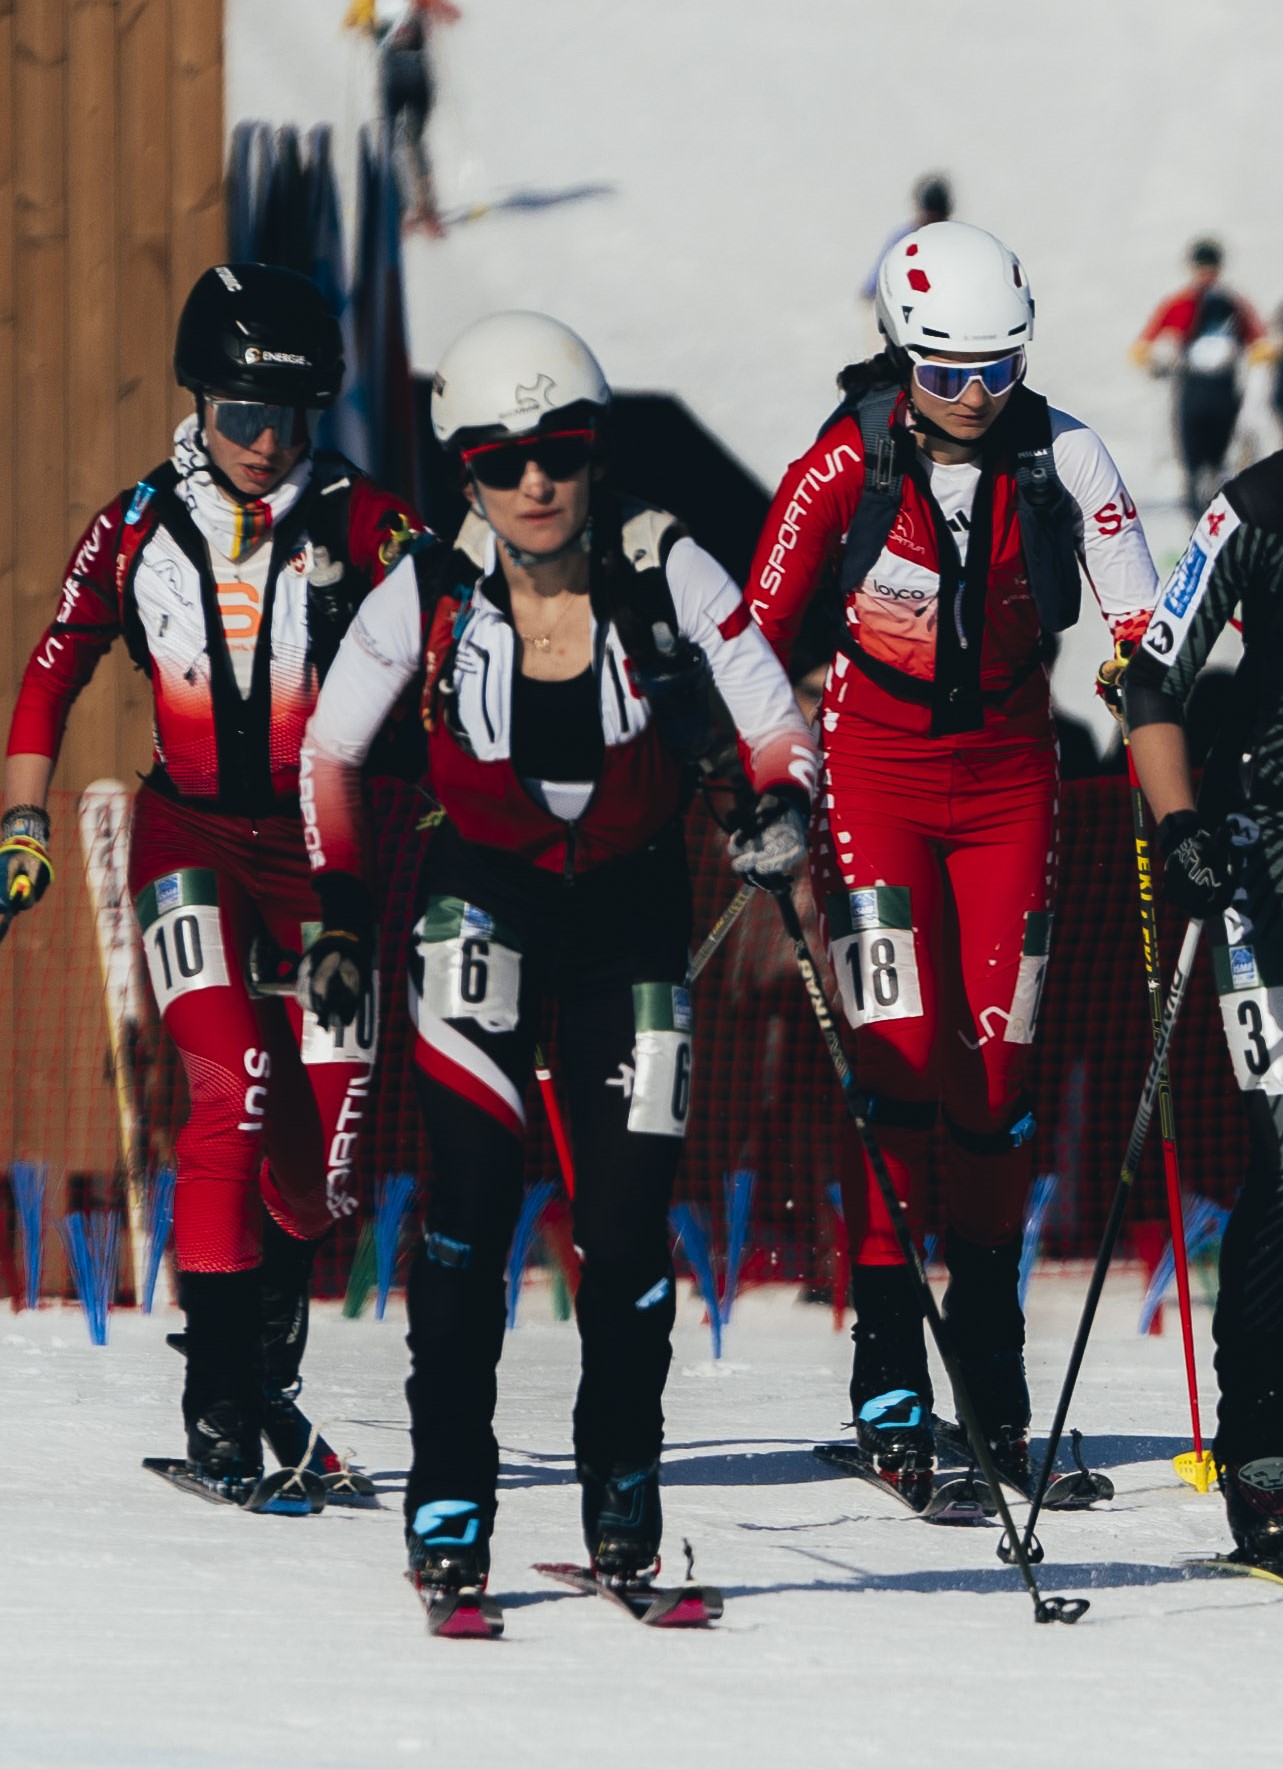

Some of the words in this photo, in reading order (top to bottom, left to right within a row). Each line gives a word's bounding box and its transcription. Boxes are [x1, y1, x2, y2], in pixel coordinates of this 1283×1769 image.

[760, 444, 862, 596] SPORTIVA
[873, 579, 925, 600] loyco
[1135, 838, 1153, 902] LEKI
[154, 914, 202, 990] 10
[460, 938, 489, 1004] 6
[845, 938, 900, 1012] 18
[1237, 999, 1271, 1076] 3
[238, 1047, 272, 1132] SUI
[672, 1042, 690, 1121] 6
